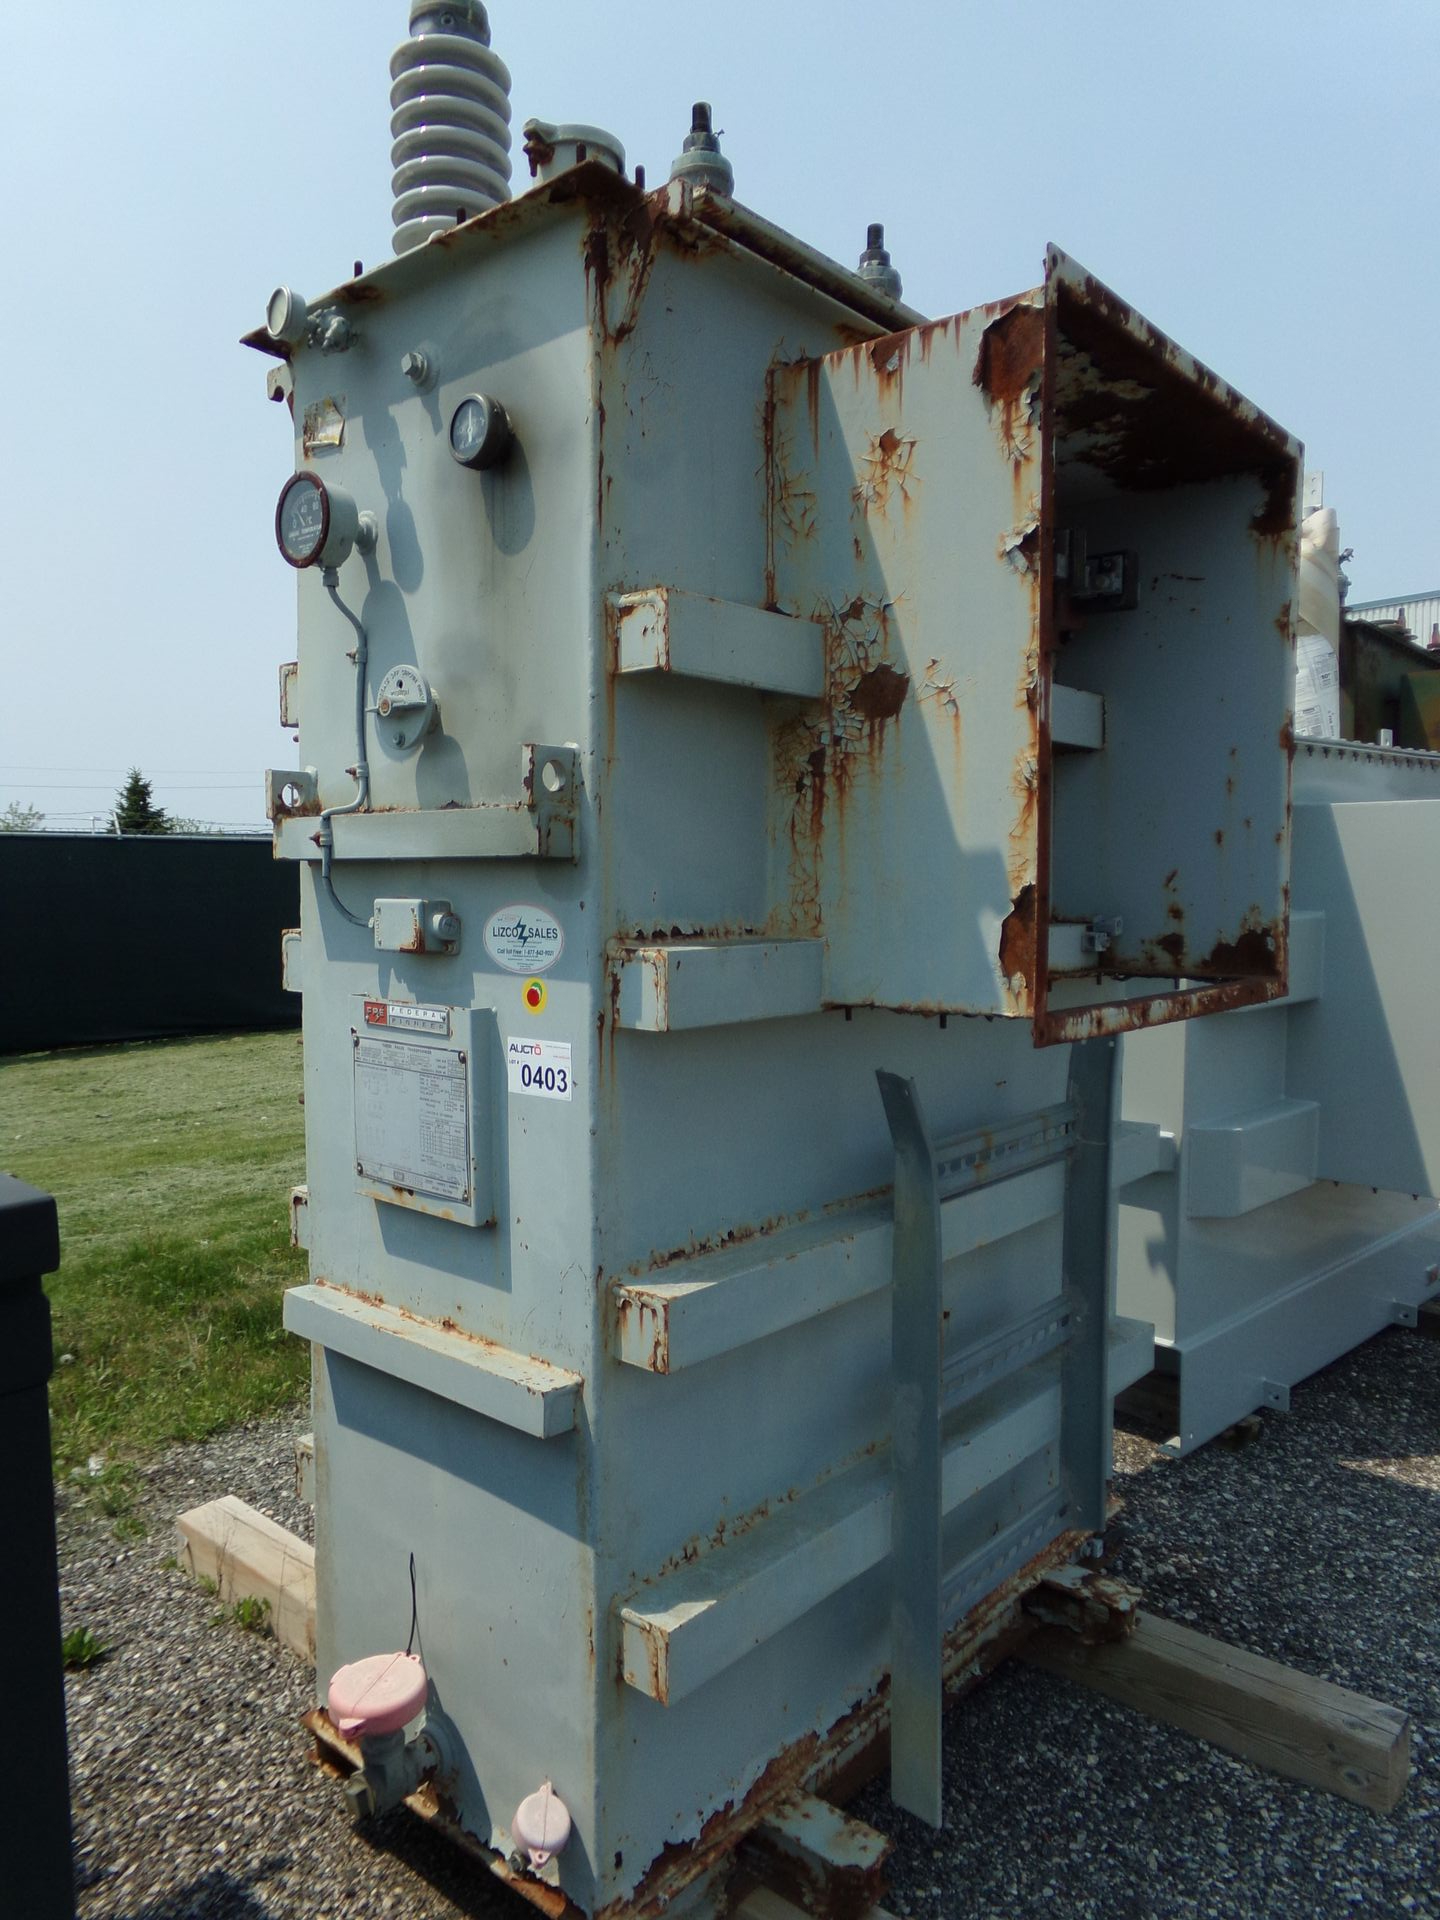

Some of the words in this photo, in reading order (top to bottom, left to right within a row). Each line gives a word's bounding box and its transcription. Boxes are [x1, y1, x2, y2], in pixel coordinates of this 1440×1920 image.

[492, 926, 519, 938] LIZCO
[528, 927, 559, 939] SALES
[391, 1007, 446, 1020] FEDERAL
[391, 1018, 445, 1031] PIONEER
[521, 1064, 568, 1093] 0403
